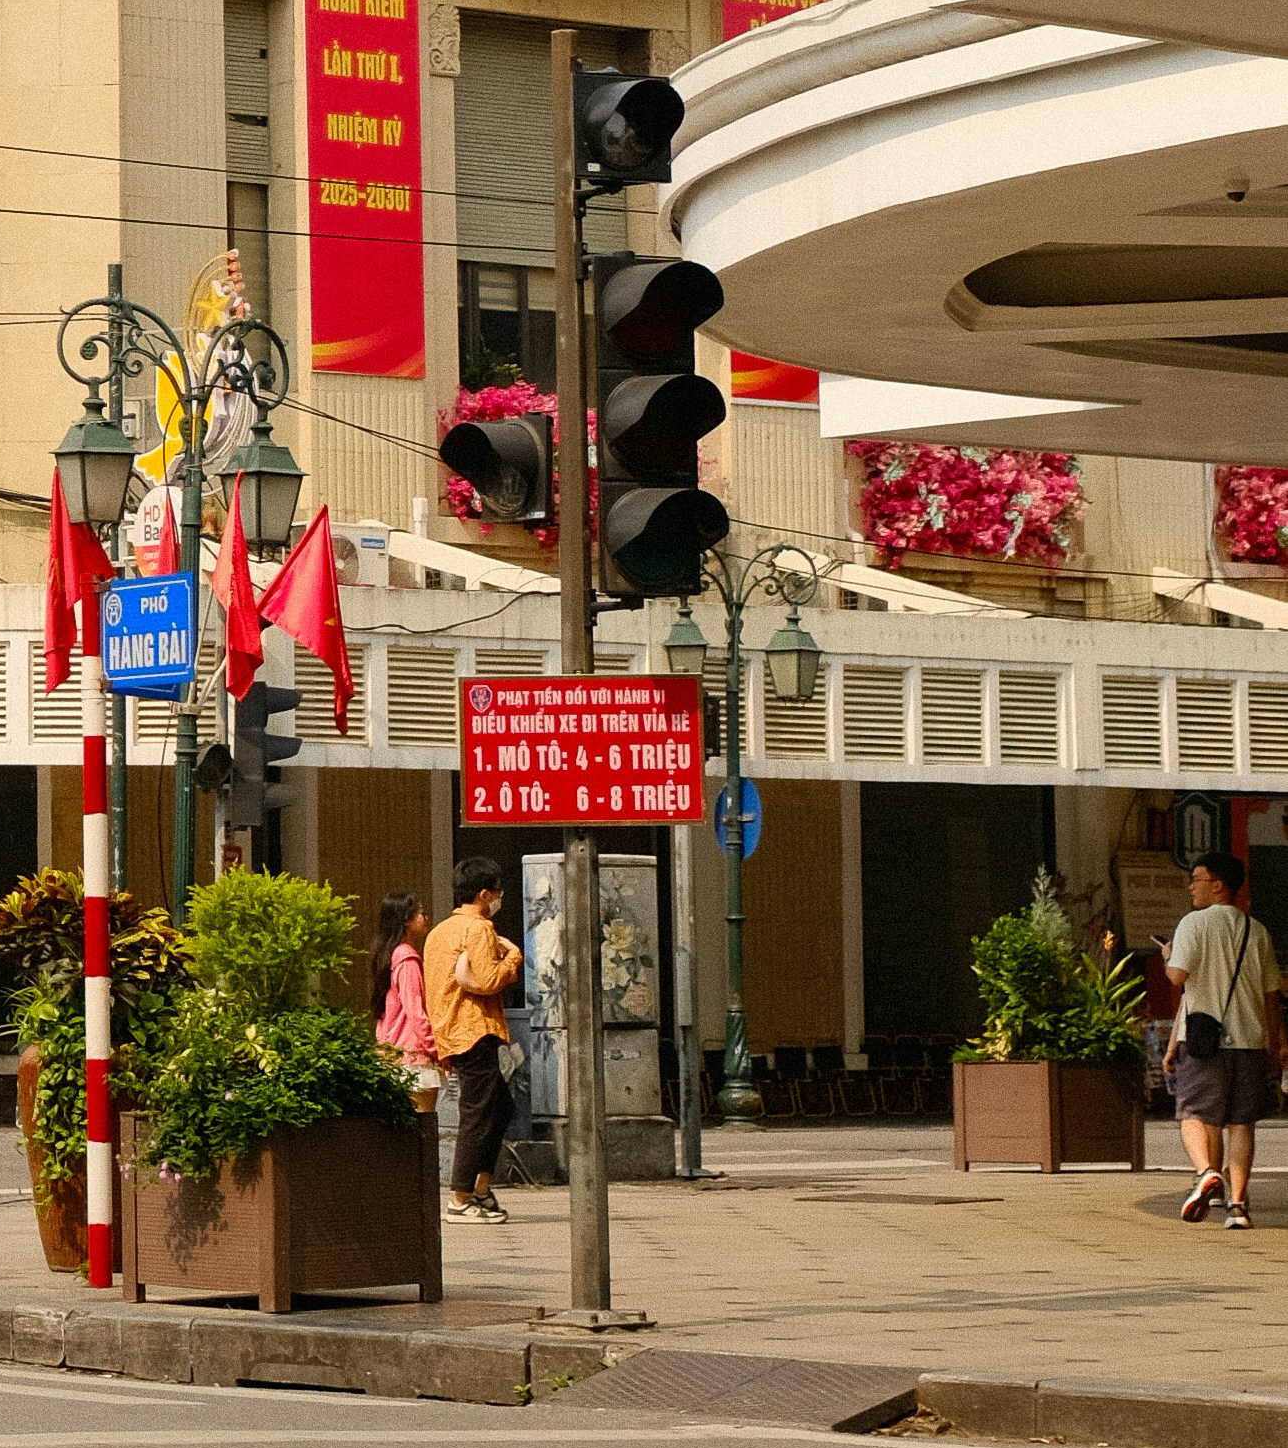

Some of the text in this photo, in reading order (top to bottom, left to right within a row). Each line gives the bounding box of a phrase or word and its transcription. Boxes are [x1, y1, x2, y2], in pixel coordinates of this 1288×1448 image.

[324, 39, 352, 77] LẦN
[357, 49, 386, 82] THỨ
[327, 111, 402, 148] NHIỆM KỲ
[320, 177, 411, 212] 2025-2030!
[143, 504, 161, 524] HD
[140, 586, 169, 615] PHỐ
[108, 622, 186, 671] HÀNG BÀI
[497, 690, 530, 708] PHẠT
[565, 685, 587, 705] ĐỐI
[590, 687, 611, 705] VỚI
[614, 686, 650, 705] HÀNH
[653, 689, 665, 705] VI
[510, 707, 555, 734] KHIỂN
[559, 714, 578, 733] XE
[581, 714, 597, 733] ĐI
[601, 709, 639, 733] TRÊN
[643, 707, 667, 733] VỈA
[671, 709, 690, 732] HÈ
[473, 745, 492, 772] 1.
[498, 739, 530, 771] MÔ
[536, 739, 568, 771] TÔ:
[576, 745, 588, 771] 4
[609, 744, 622, 770] 6
[629, 738, 691, 775] TRIỆU
[474, 787, 493, 812] 2.
[499, 780, 513, 813] Ô
[518, 780, 550, 812] TÔ:
[576, 786, 589, 812] 6
[610, 785, 623, 811] 8
[631, 779, 690, 816] TRIỆU
